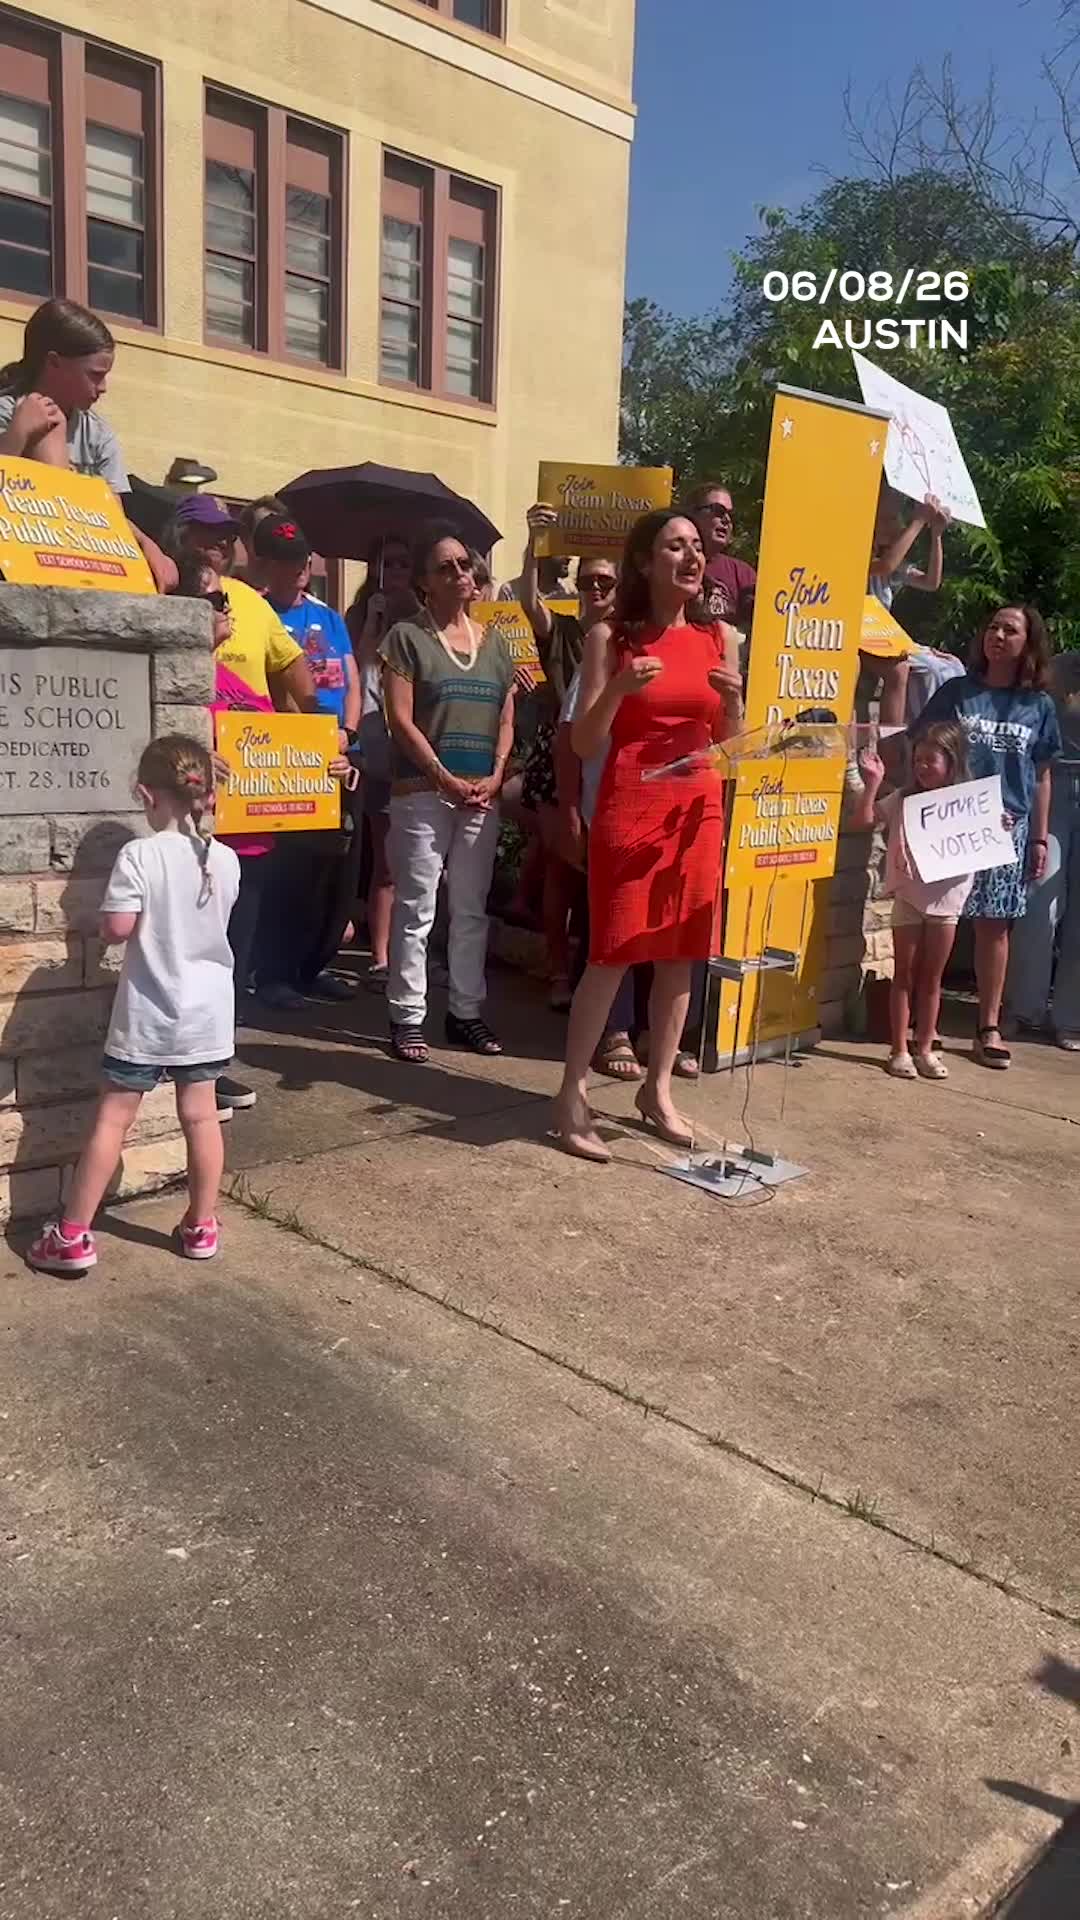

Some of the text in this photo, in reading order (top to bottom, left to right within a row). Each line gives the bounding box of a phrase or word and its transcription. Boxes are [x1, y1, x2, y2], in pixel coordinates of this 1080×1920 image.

[557, 474, 596, 494] Join
[0, 488, 110, 530] Team Texas
[563, 489, 654, 512] Team Texas
[558, 511, 597, 530] ublic
[0, 515, 140, 560] Public Schools
[774, 567, 830, 615] Join
[488, 611, 520, 626] Join
[784, 602, 844, 651] Team
[35, 674, 119, 699] PUBLIC
[776, 653, 840, 700] Texas
[23, 706, 126, 729] SCHOOL
[0, 741, 90, 757] DEDICATED
[235, 725, 272, 752] Join
[243, 744, 323, 769] Team Texas
[69, 770, 111, 789] 1876
[228, 770, 337, 797] Public Schools
[752, 775, 785, 800] Join
[755, 793, 828, 819] Team Texas
[920, 791, 990, 831] FUTURE
[738, 818, 835, 849] Public Schools
[930, 827, 1000, 860] VOTER
